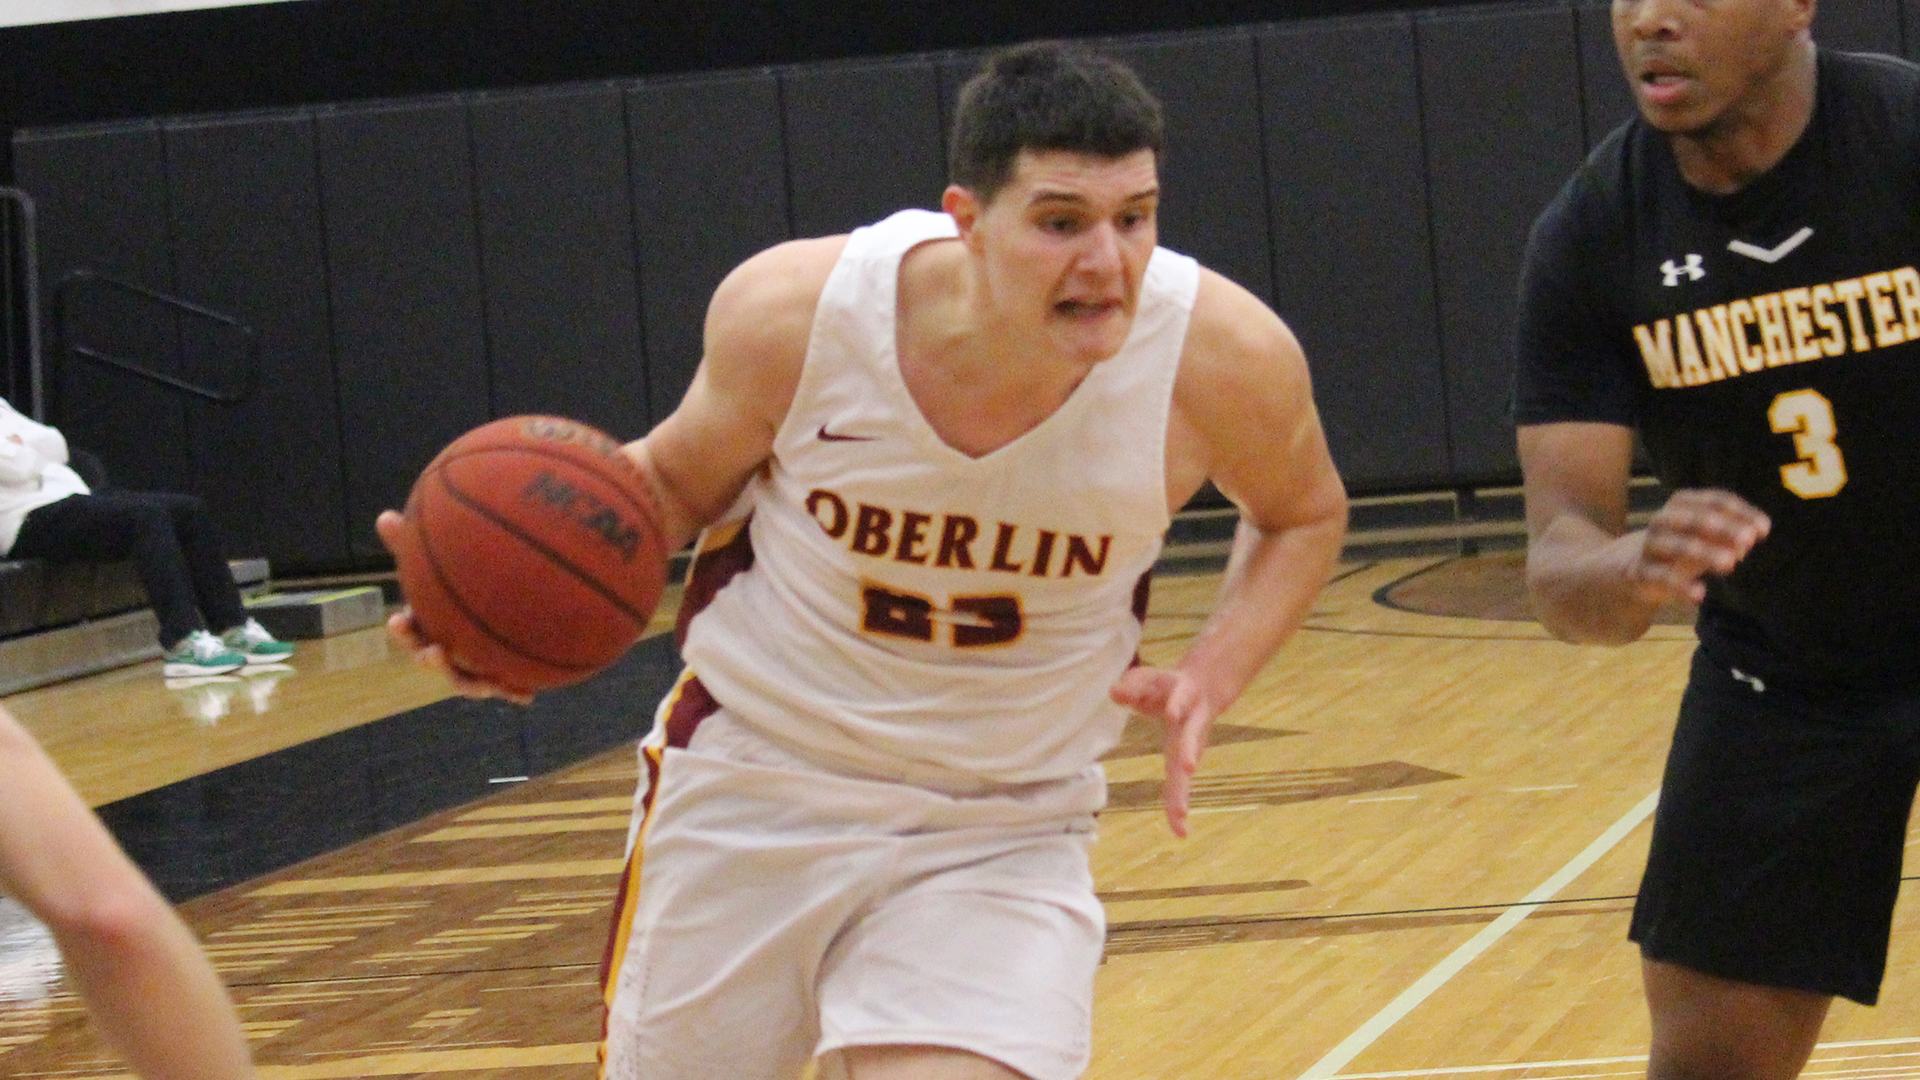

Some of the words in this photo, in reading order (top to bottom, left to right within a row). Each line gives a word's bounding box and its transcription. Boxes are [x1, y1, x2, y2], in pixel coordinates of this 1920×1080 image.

[1633, 267, 1920, 388] MANCHESTER
[1768, 389, 1848, 499] 3
[524, 471, 640, 562] NCAA
[805, 488, 1113, 578] OBERLIN
